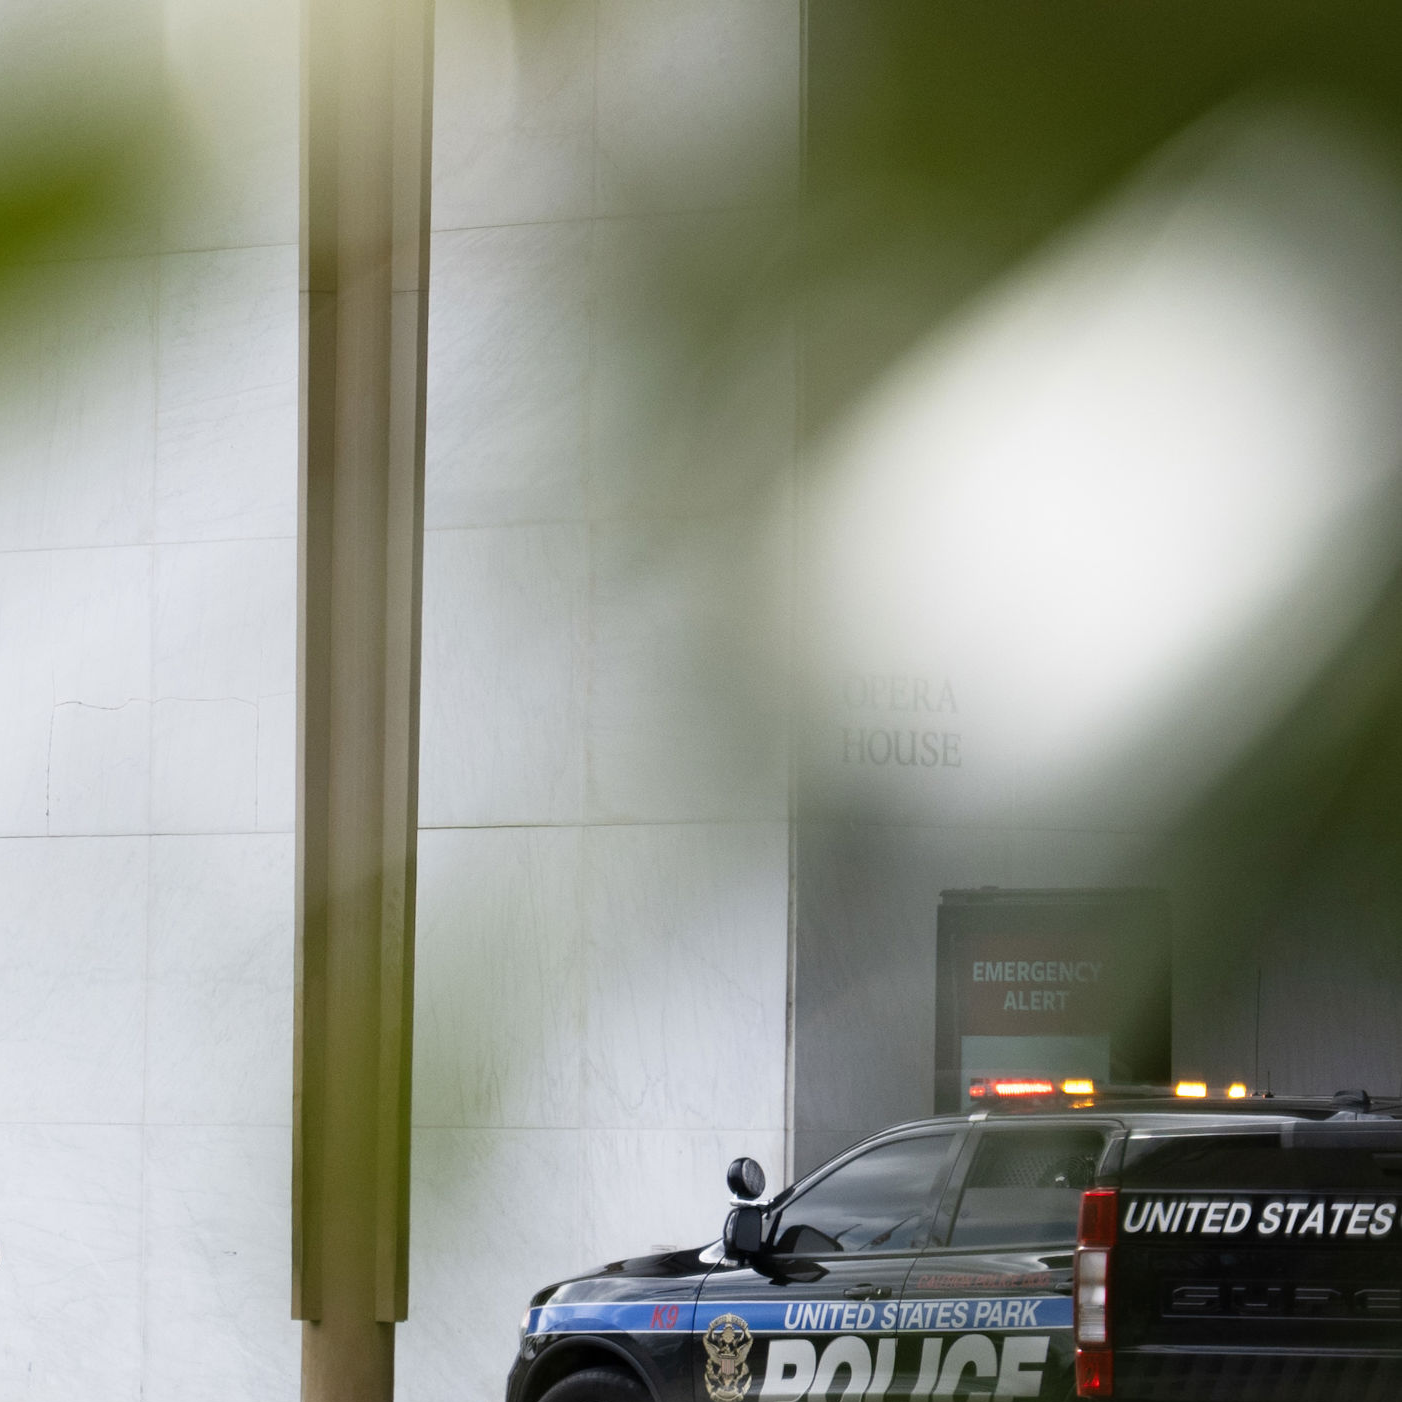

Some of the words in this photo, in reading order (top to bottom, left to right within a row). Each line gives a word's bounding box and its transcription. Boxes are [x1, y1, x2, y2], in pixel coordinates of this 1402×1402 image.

[843, 674, 960, 715] OPERA
[840, 726, 963, 769] HOUSE
[972, 961, 1101, 983] EMERGENCY
[1003, 990, 1069, 1011] ALERT
[1123, 1202, 1252, 1234] UNITED
[1257, 1202, 1397, 1236] STATES
[650, 1304, 679, 1329] K9
[784, 1303, 875, 1330] UNITED
[880, 1302, 969, 1328] STATES
[974, 1300, 1044, 1327] PARK
